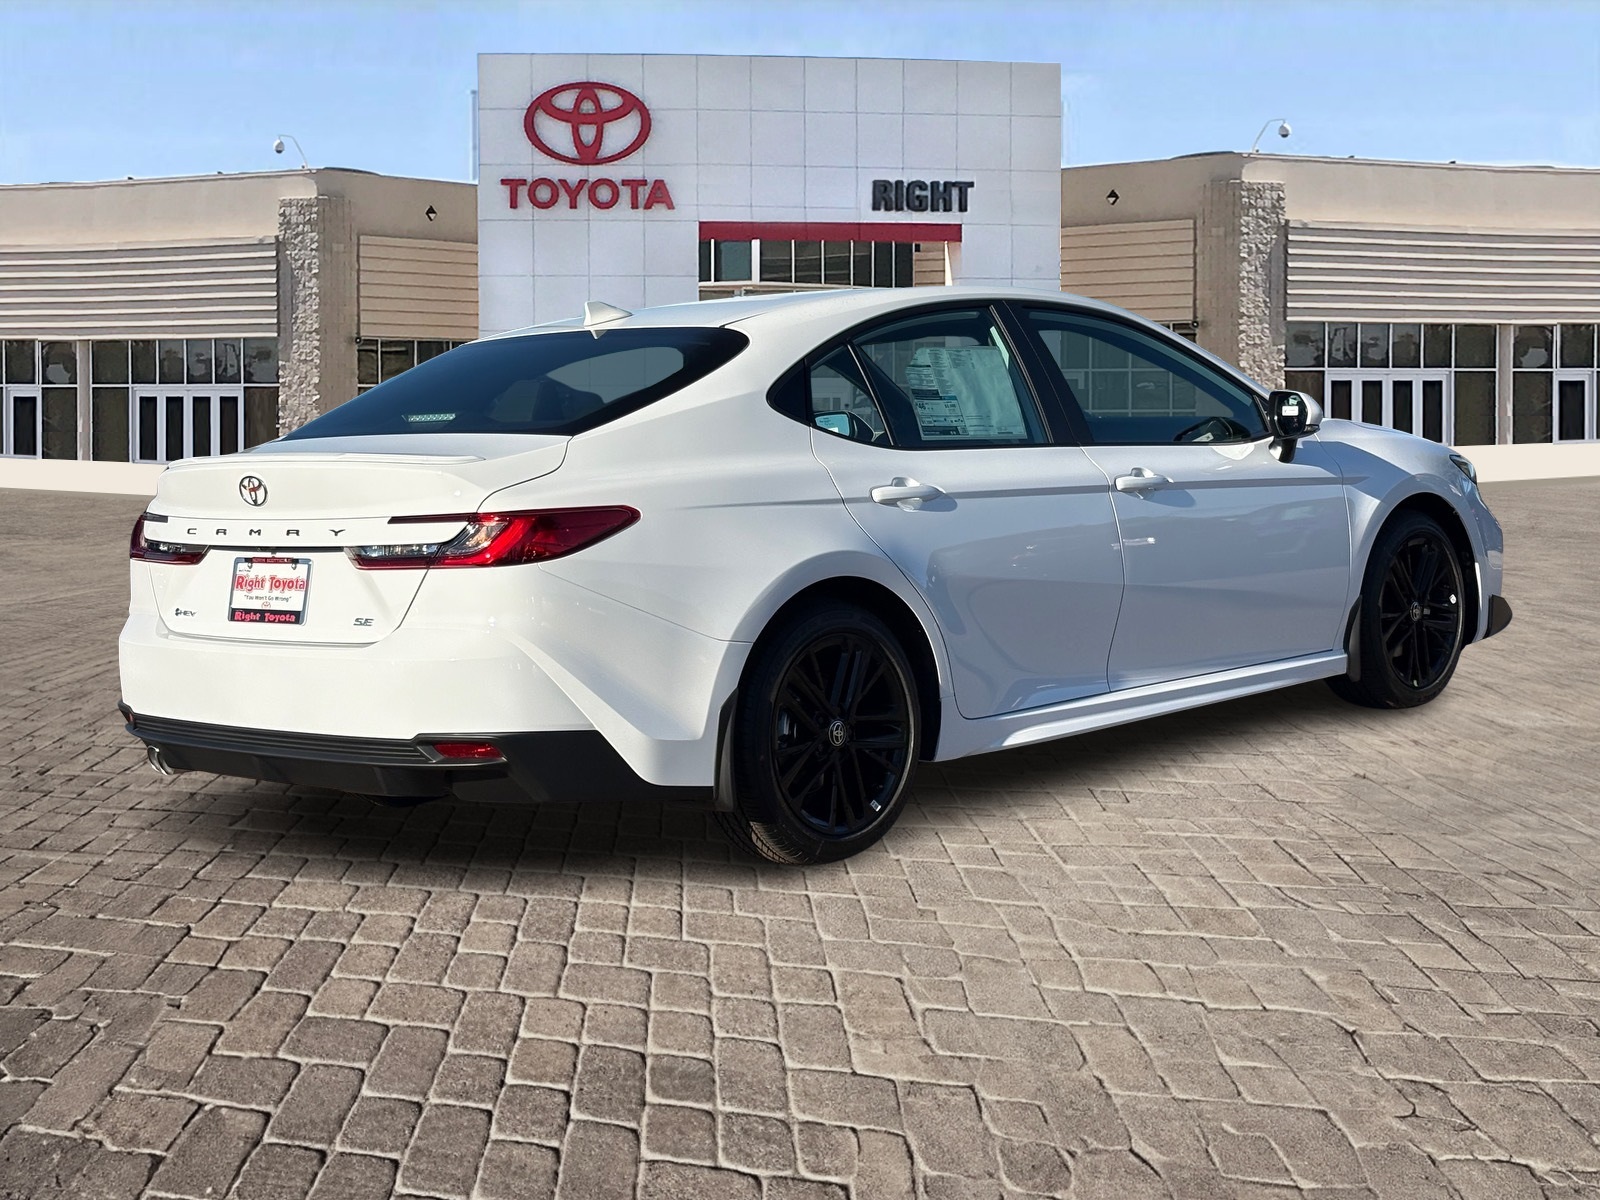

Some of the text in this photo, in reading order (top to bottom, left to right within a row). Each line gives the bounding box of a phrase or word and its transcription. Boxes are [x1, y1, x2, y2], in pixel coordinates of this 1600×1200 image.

[500, 177, 675, 210] TOYOTA
[872, 180, 974, 212] RIGHT
[187, 528, 346, 537] CAMRY
[235, 574, 306, 592] Right Toyota
[234, 611, 296, 622] Right Toyota
[353, 617, 374, 626] SE
